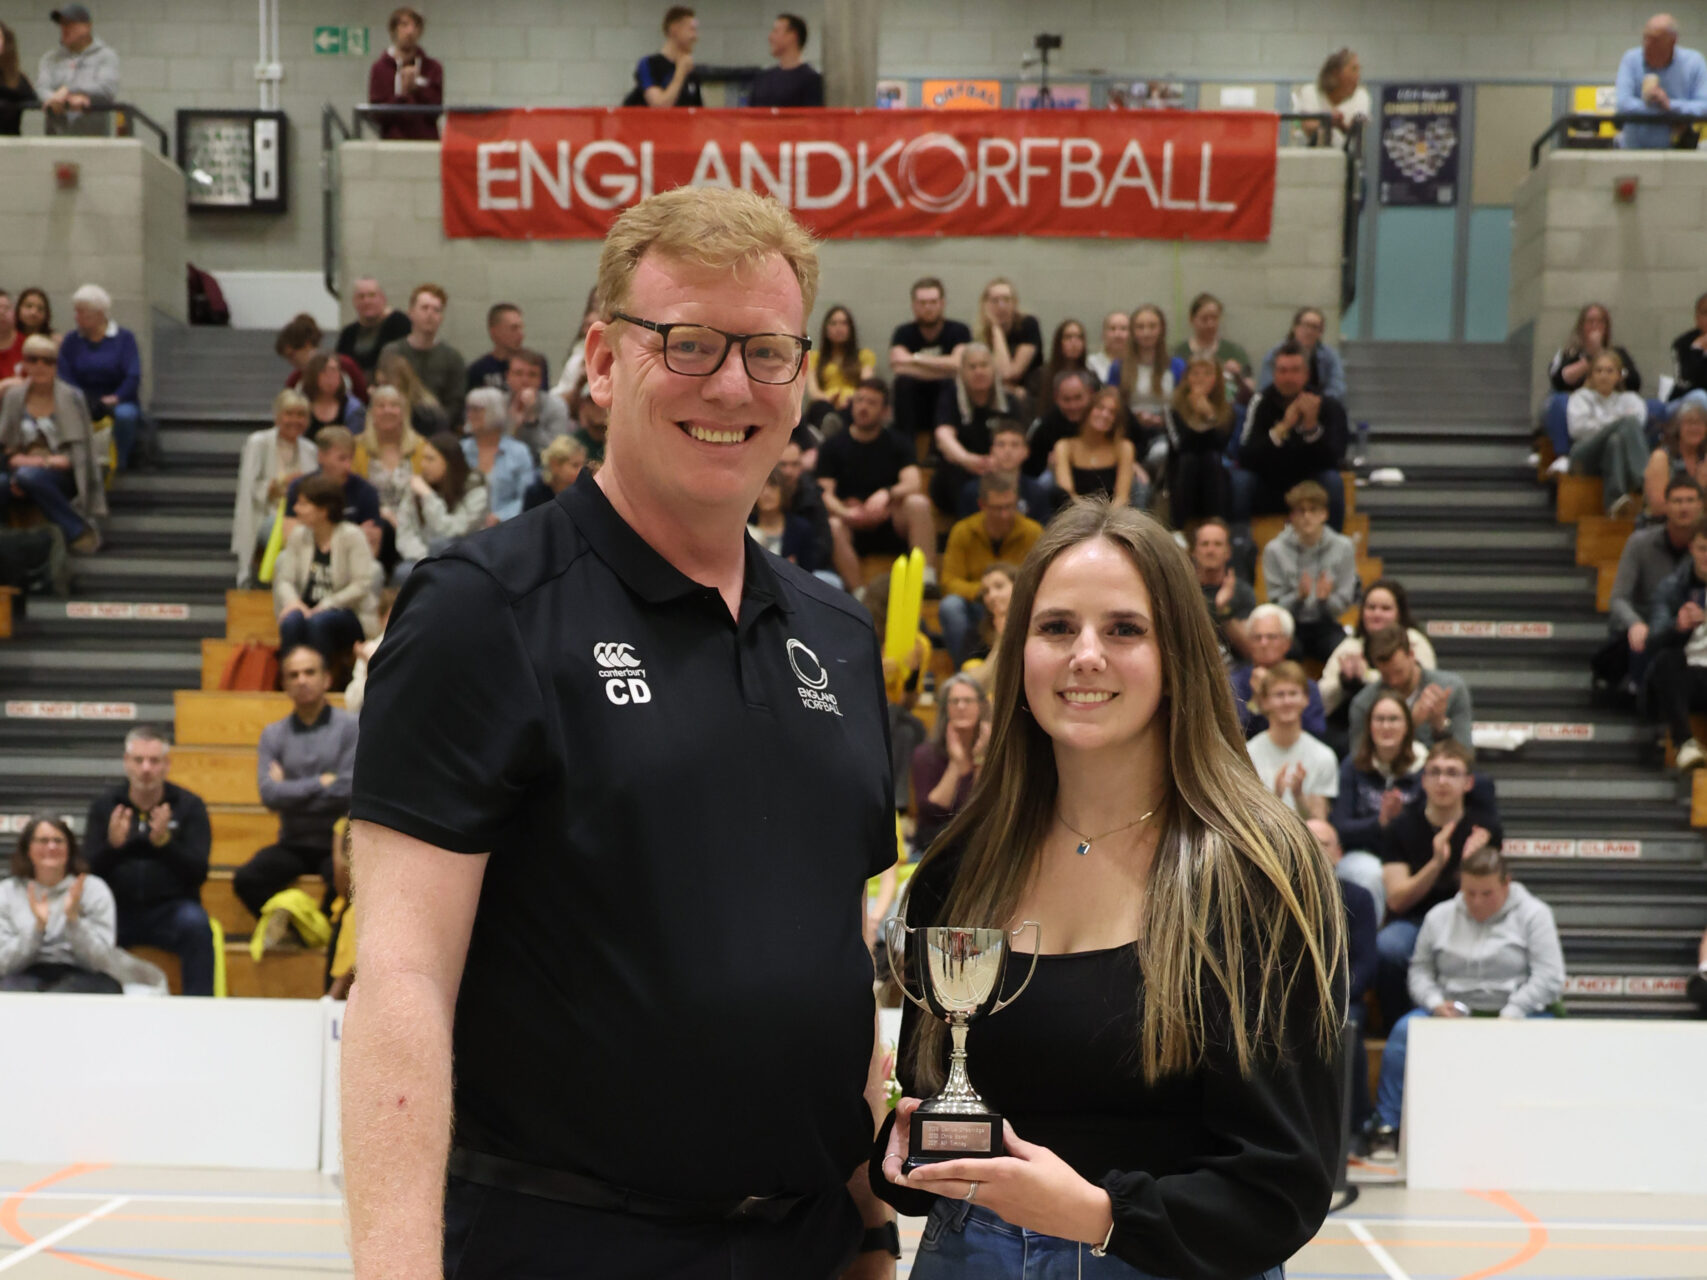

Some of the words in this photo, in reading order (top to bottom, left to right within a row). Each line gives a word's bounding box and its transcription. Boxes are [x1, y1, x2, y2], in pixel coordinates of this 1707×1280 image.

[599, 668, 646, 678] canterbury
[605, 678, 652, 705] CD
[797, 686, 838, 705] ENGLAND
[802, 698, 844, 716] KORFBALL
